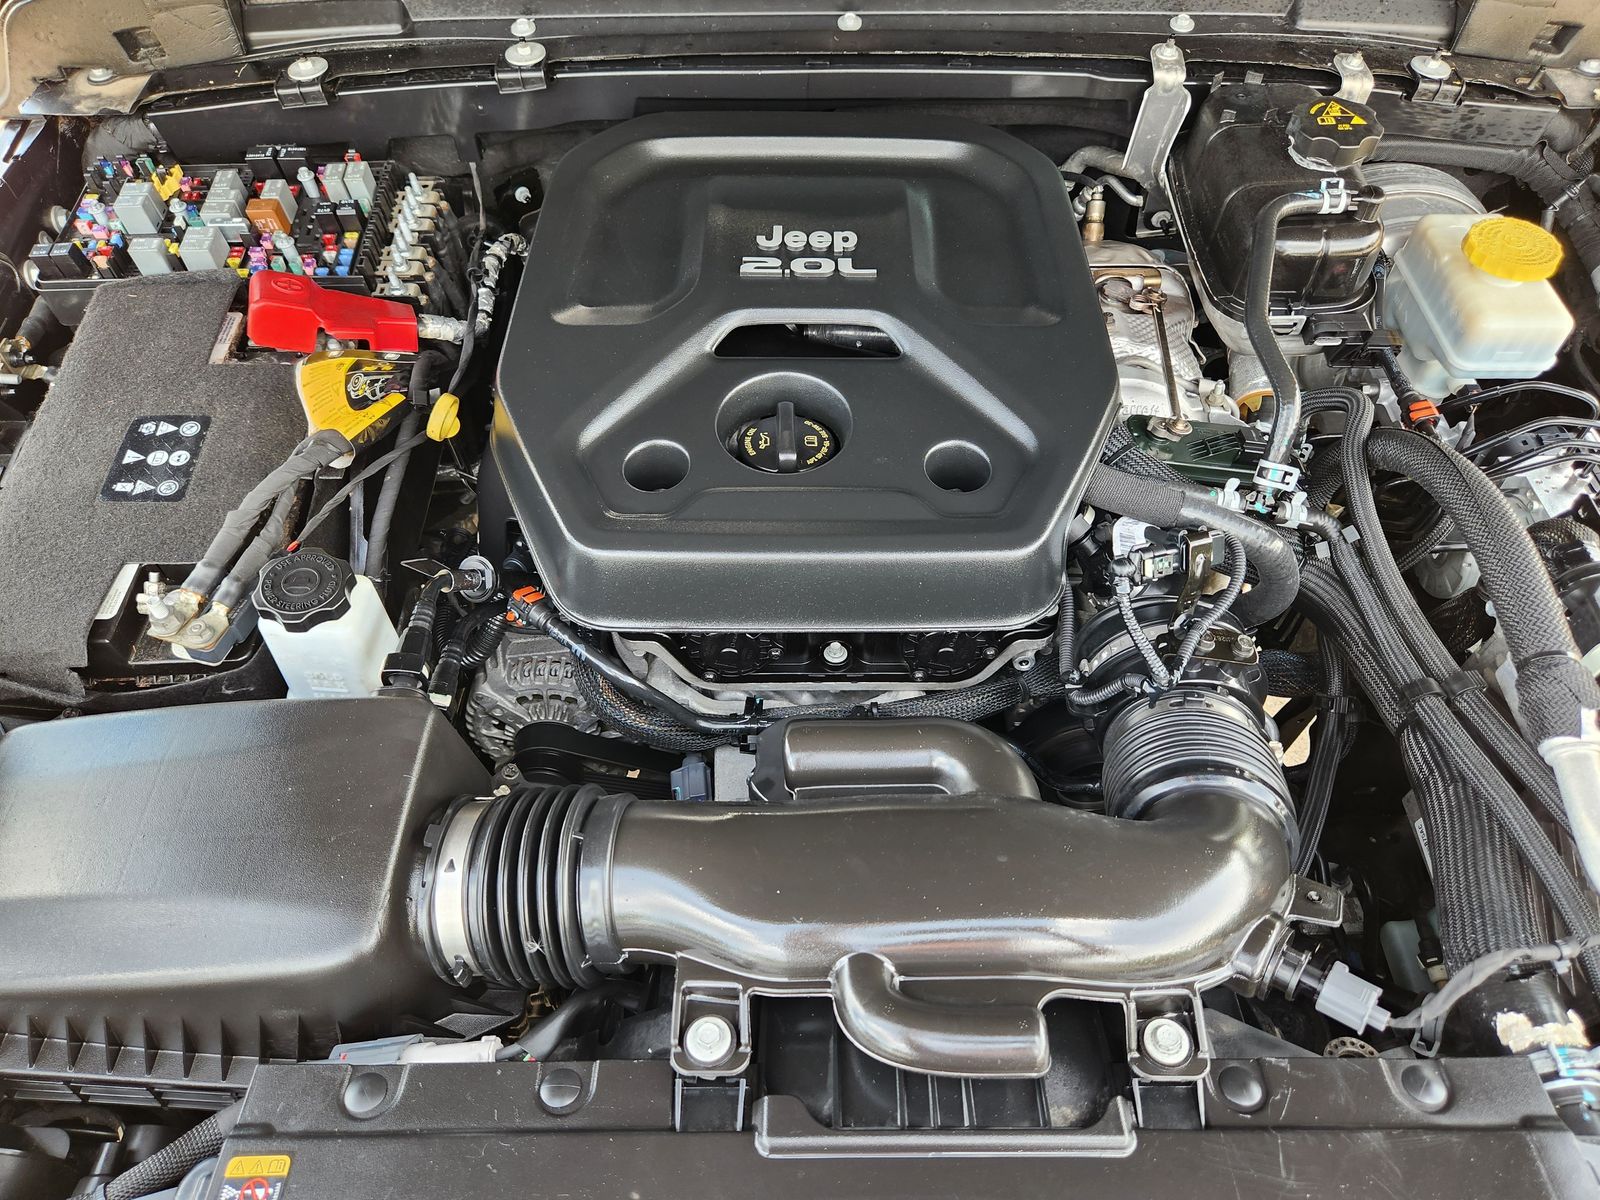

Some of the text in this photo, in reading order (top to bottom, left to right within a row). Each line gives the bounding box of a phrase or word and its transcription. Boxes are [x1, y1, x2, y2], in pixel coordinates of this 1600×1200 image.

[756, 225, 858, 255] Jeep
[740, 257, 877, 277] 2.0L
[744, 428, 758, 456] ENGINE OIL
[275, 554, 335, 571] USE APPROVED
[263, 579, 337, 611] POWER STEERING FLUID
